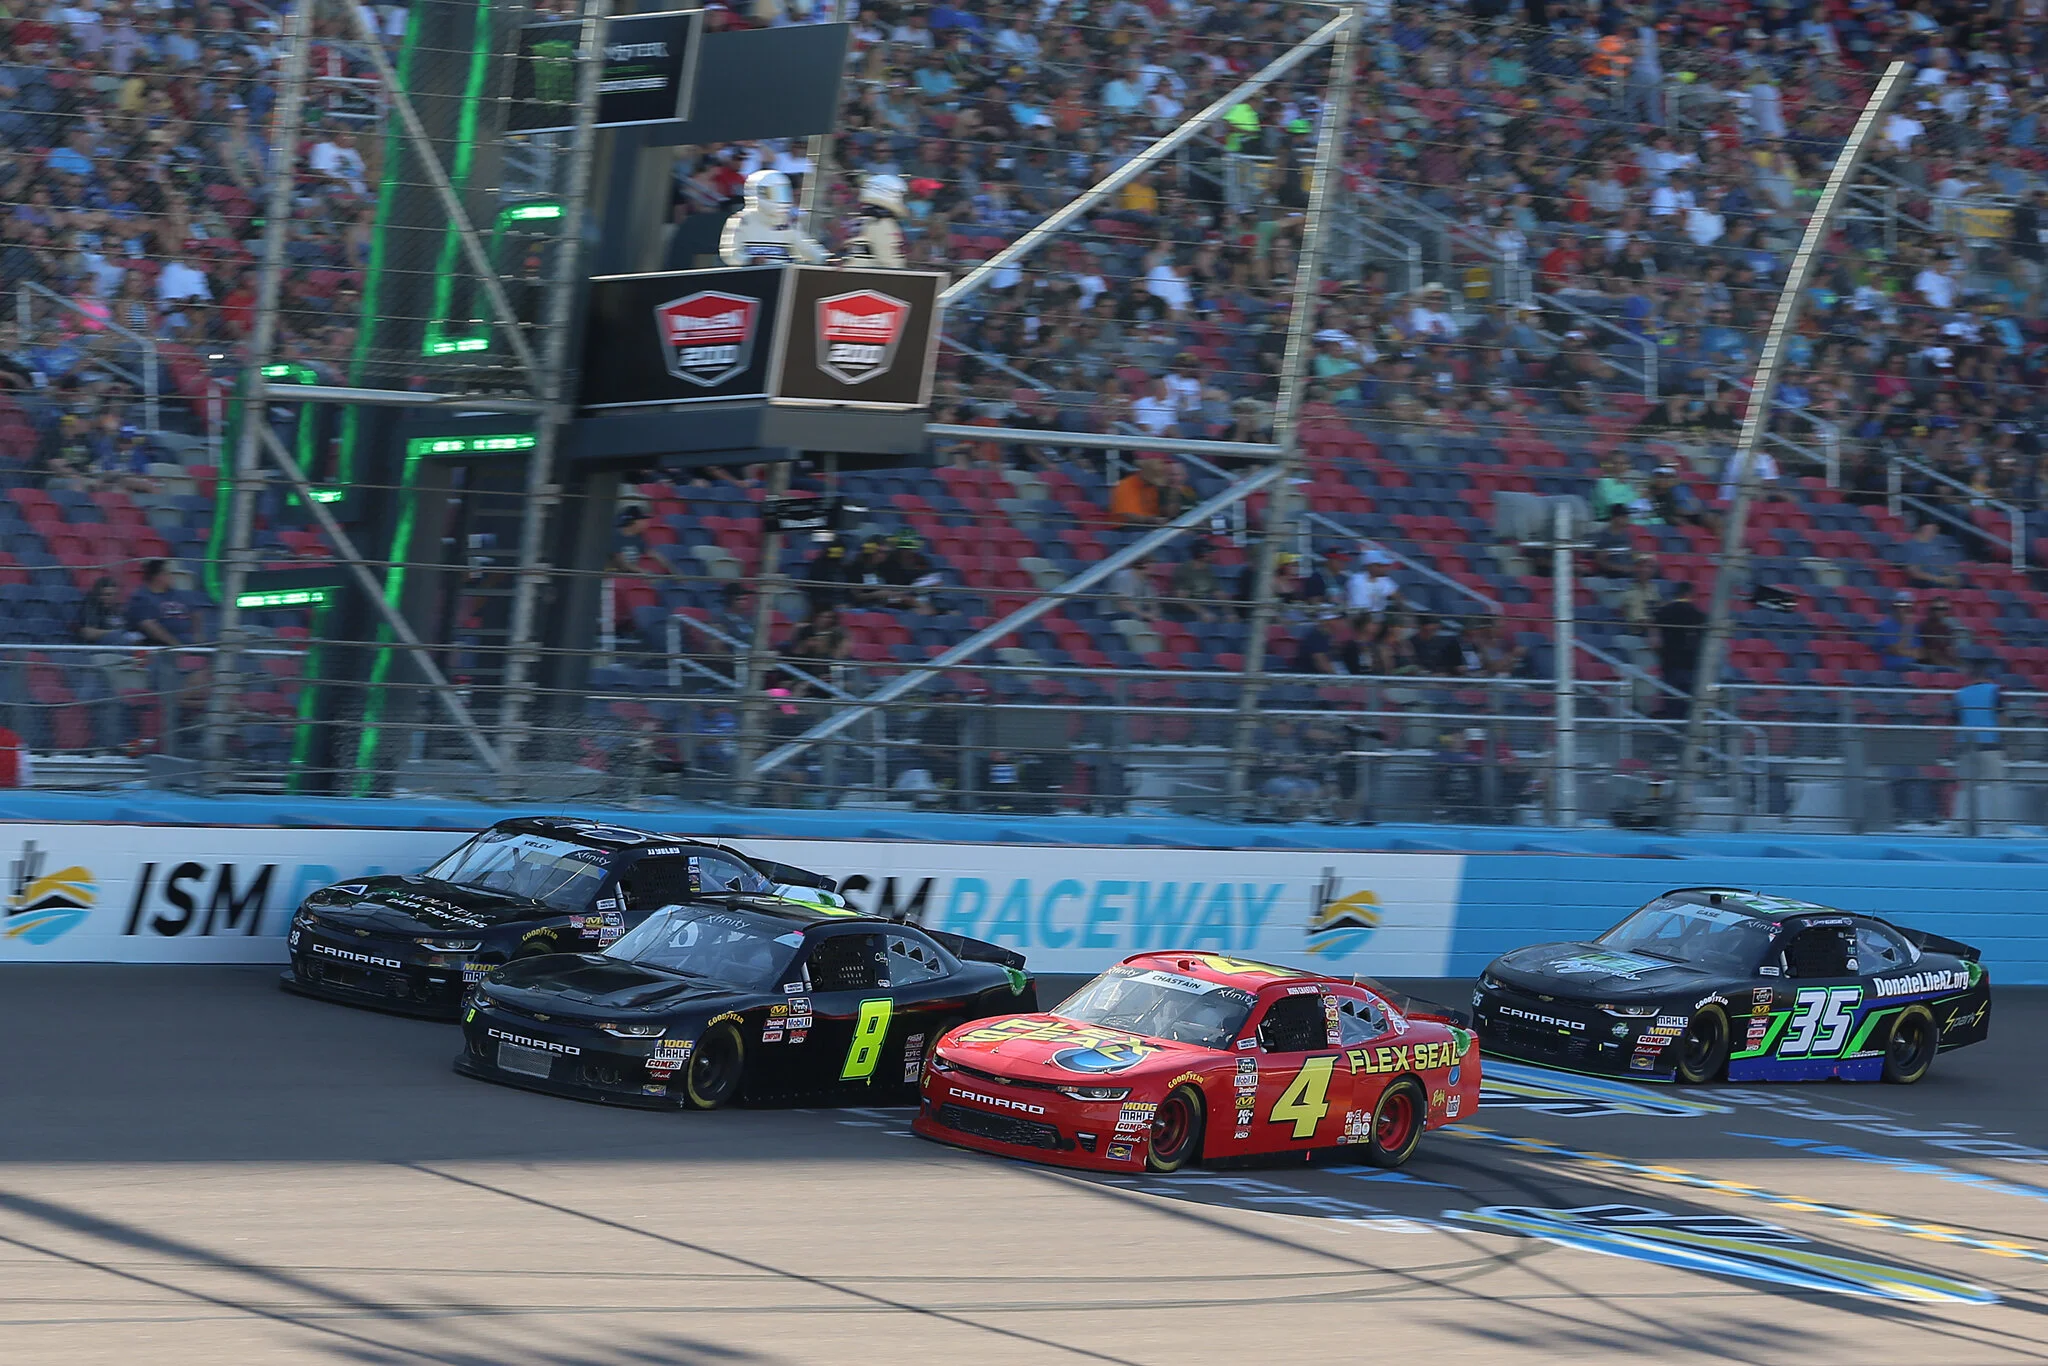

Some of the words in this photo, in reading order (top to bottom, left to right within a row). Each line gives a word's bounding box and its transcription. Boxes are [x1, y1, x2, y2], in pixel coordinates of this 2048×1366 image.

[523, 840, 553, 850] YELEY
[575, 850, 611, 866] xfinity
[124, 861, 281, 936] ISM
[385, 898, 421, 909] DATA
[836, 874, 937, 930] SM
[942, 876, 1286, 951] RACEWAY
[705, 914, 751, 930] xfinity
[1747, 920, 1782, 935] xfinity
[290, 930, 301, 945] 38
[522, 926, 558, 941] GOODYEAR
[313, 944, 401, 969] CAMARO
[1152, 974, 1202, 990] CHASTAIN
[1873, 970, 1969, 997] DonateLifeAZ.org
[1218, 988, 1258, 1007] xfinity
[1472, 991, 1484, 1006] 35
[1695, 991, 1728, 1010] GOODYEAR
[466, 1008, 476, 1023] 8
[708, 1011, 744, 1027] GOODYEAR
[1499, 1006, 1586, 1031] CAMARO
[1657, 1016, 1688, 1026] MAHLE
[1779, 986, 1862, 1059] 35
[840, 998, 893, 1081] 8
[1648, 1027, 1683, 1036] MOOG
[488, 1028, 580, 1056] CAMARO
[656, 1049, 690, 1058] MAHLE
[1347, 1045, 1412, 1075] FLEX
[1414, 1040, 1461, 1071] SEAL
[924, 1075, 931, 1089] 4
[1168, 1071, 1204, 1089] GOODYEAR
[949, 1087, 1045, 1115] CAMARO
[1269, 1053, 1342, 1141] 4
[1122, 1102, 1158, 1111] MOOG
